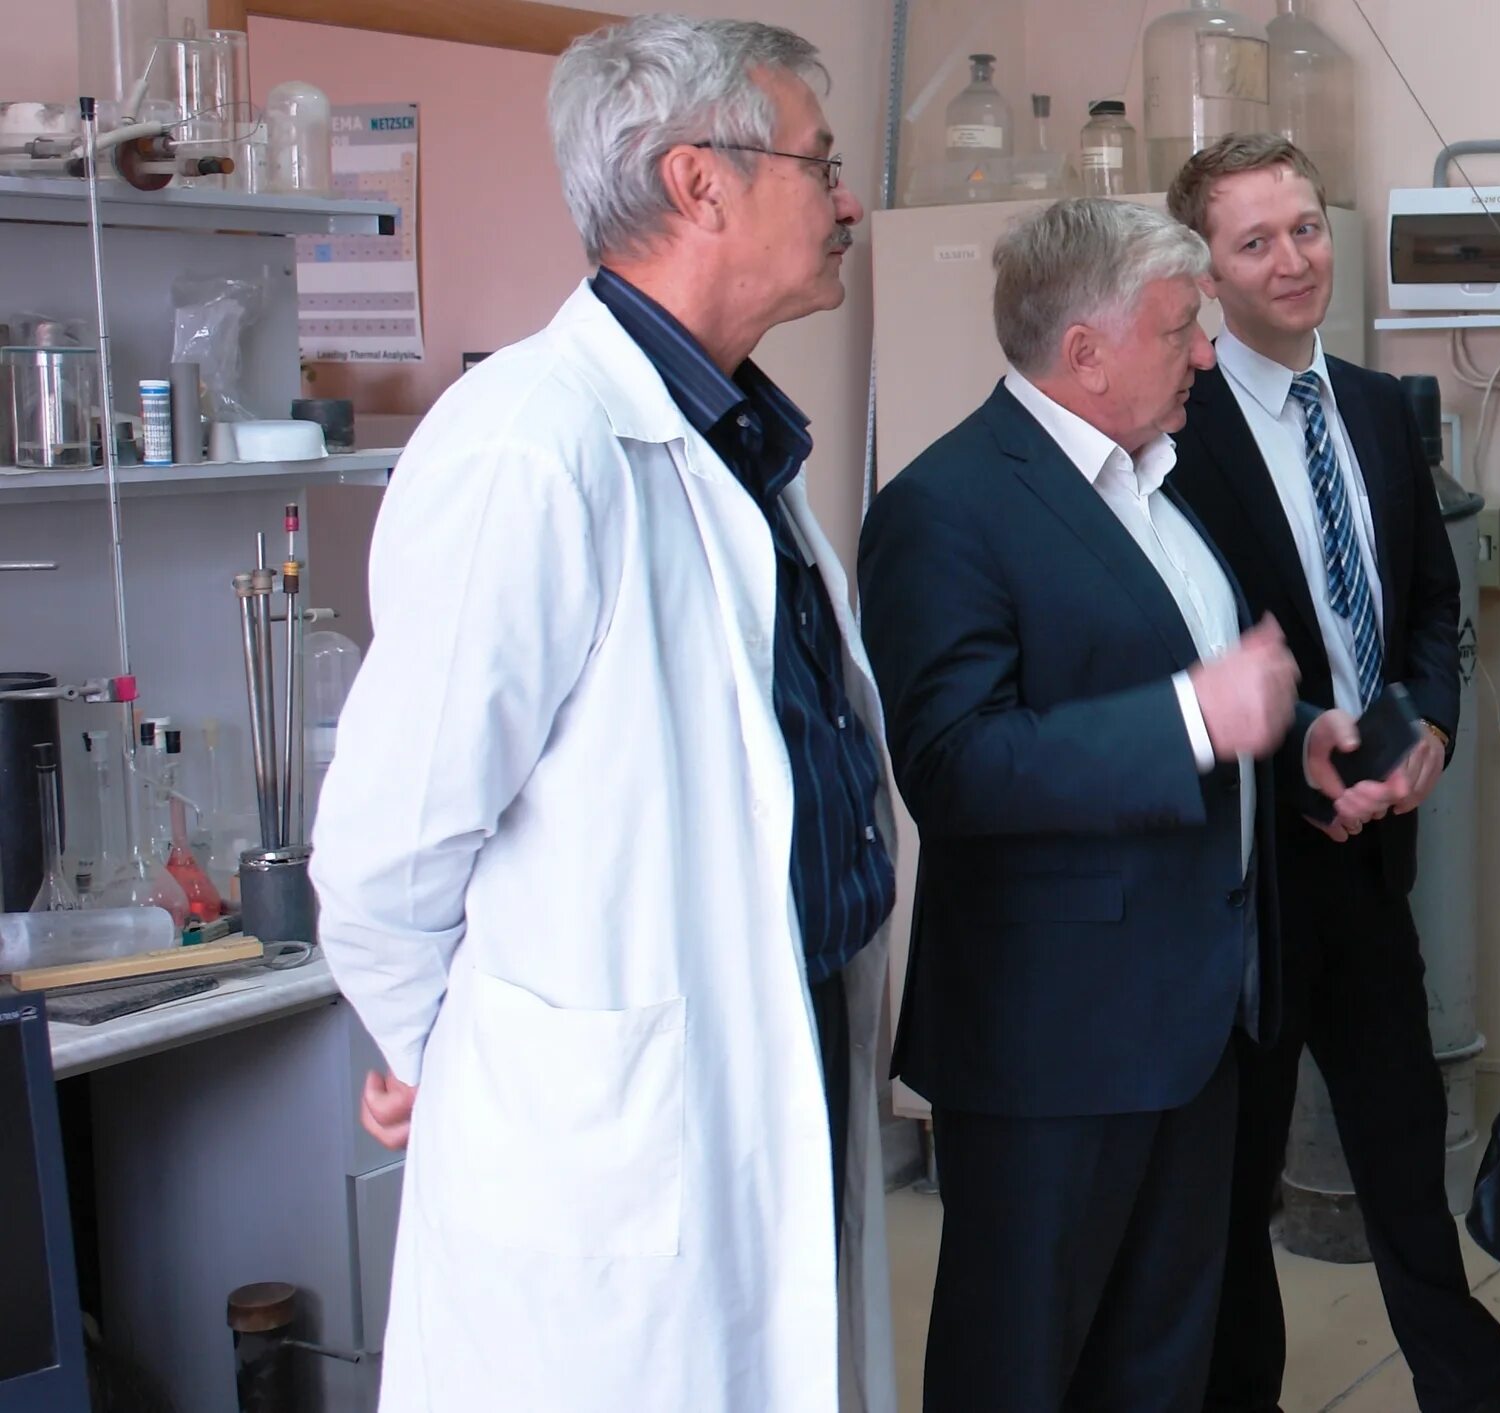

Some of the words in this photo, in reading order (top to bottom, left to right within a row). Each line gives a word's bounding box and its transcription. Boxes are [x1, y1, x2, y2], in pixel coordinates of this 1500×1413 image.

[370, 117, 415, 130] NETZSCH
[350, 350, 381, 358] Thermal
[383, 350, 415, 360] Analysis
